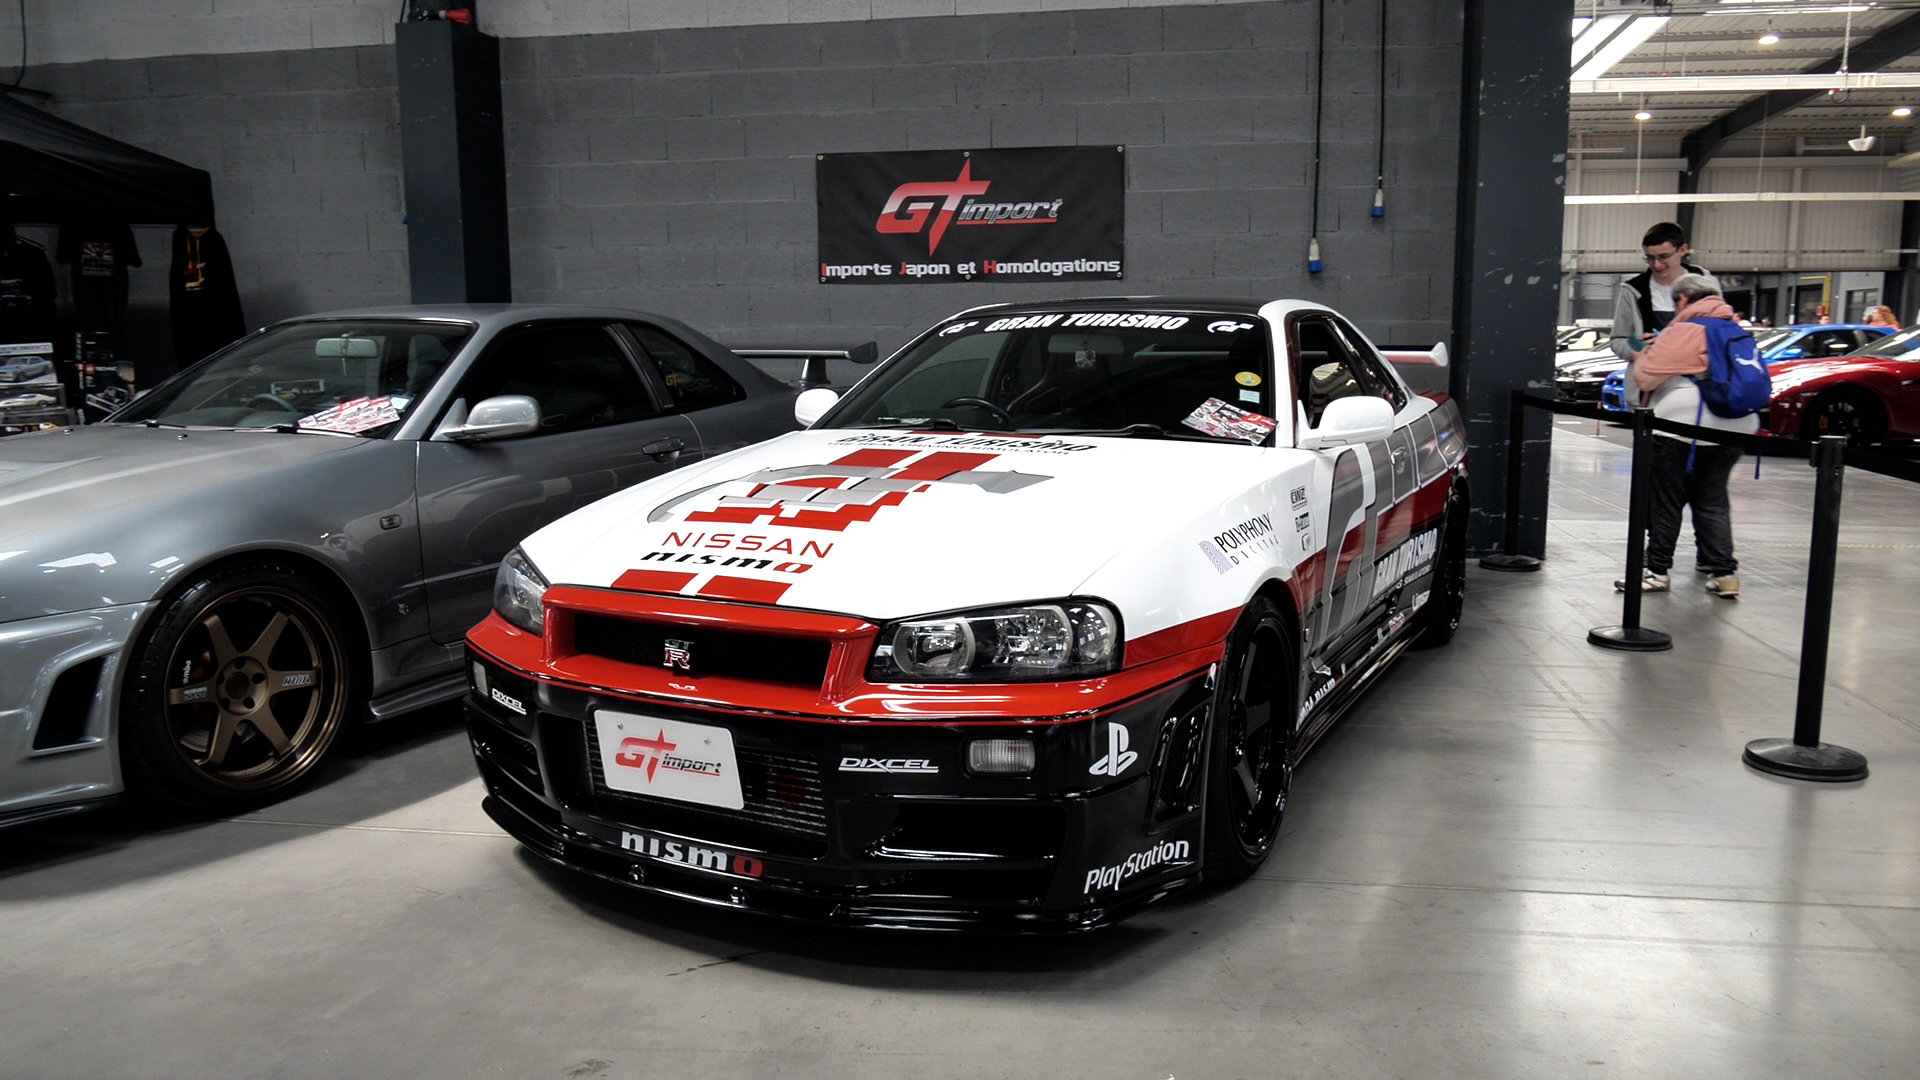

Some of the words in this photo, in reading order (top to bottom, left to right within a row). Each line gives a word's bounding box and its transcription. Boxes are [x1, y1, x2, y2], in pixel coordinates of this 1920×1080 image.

[958, 198, 1064, 225] import
[821, 262, 892, 279] Imports
[899, 261, 951, 277] Japon
[956, 260, 977, 275] et
[983, 258, 1121, 276] Homologations
[984, 314, 1060, 333] GRAN
[1061, 313, 1190, 331] TURISMO
[937, 437, 1099, 453] TURISMO
[661, 531, 835, 558] NISSAN
[1213, 512, 1275, 554] POLYPHONY
[640, 551, 814, 574] nismo
[491, 687, 526, 715] DIXCEL
[661, 752, 723, 776] import
[838, 757, 940, 774] DIXCEL
[621, 831, 763, 878] nismo
[1083, 840, 1190, 895] PlayStation
